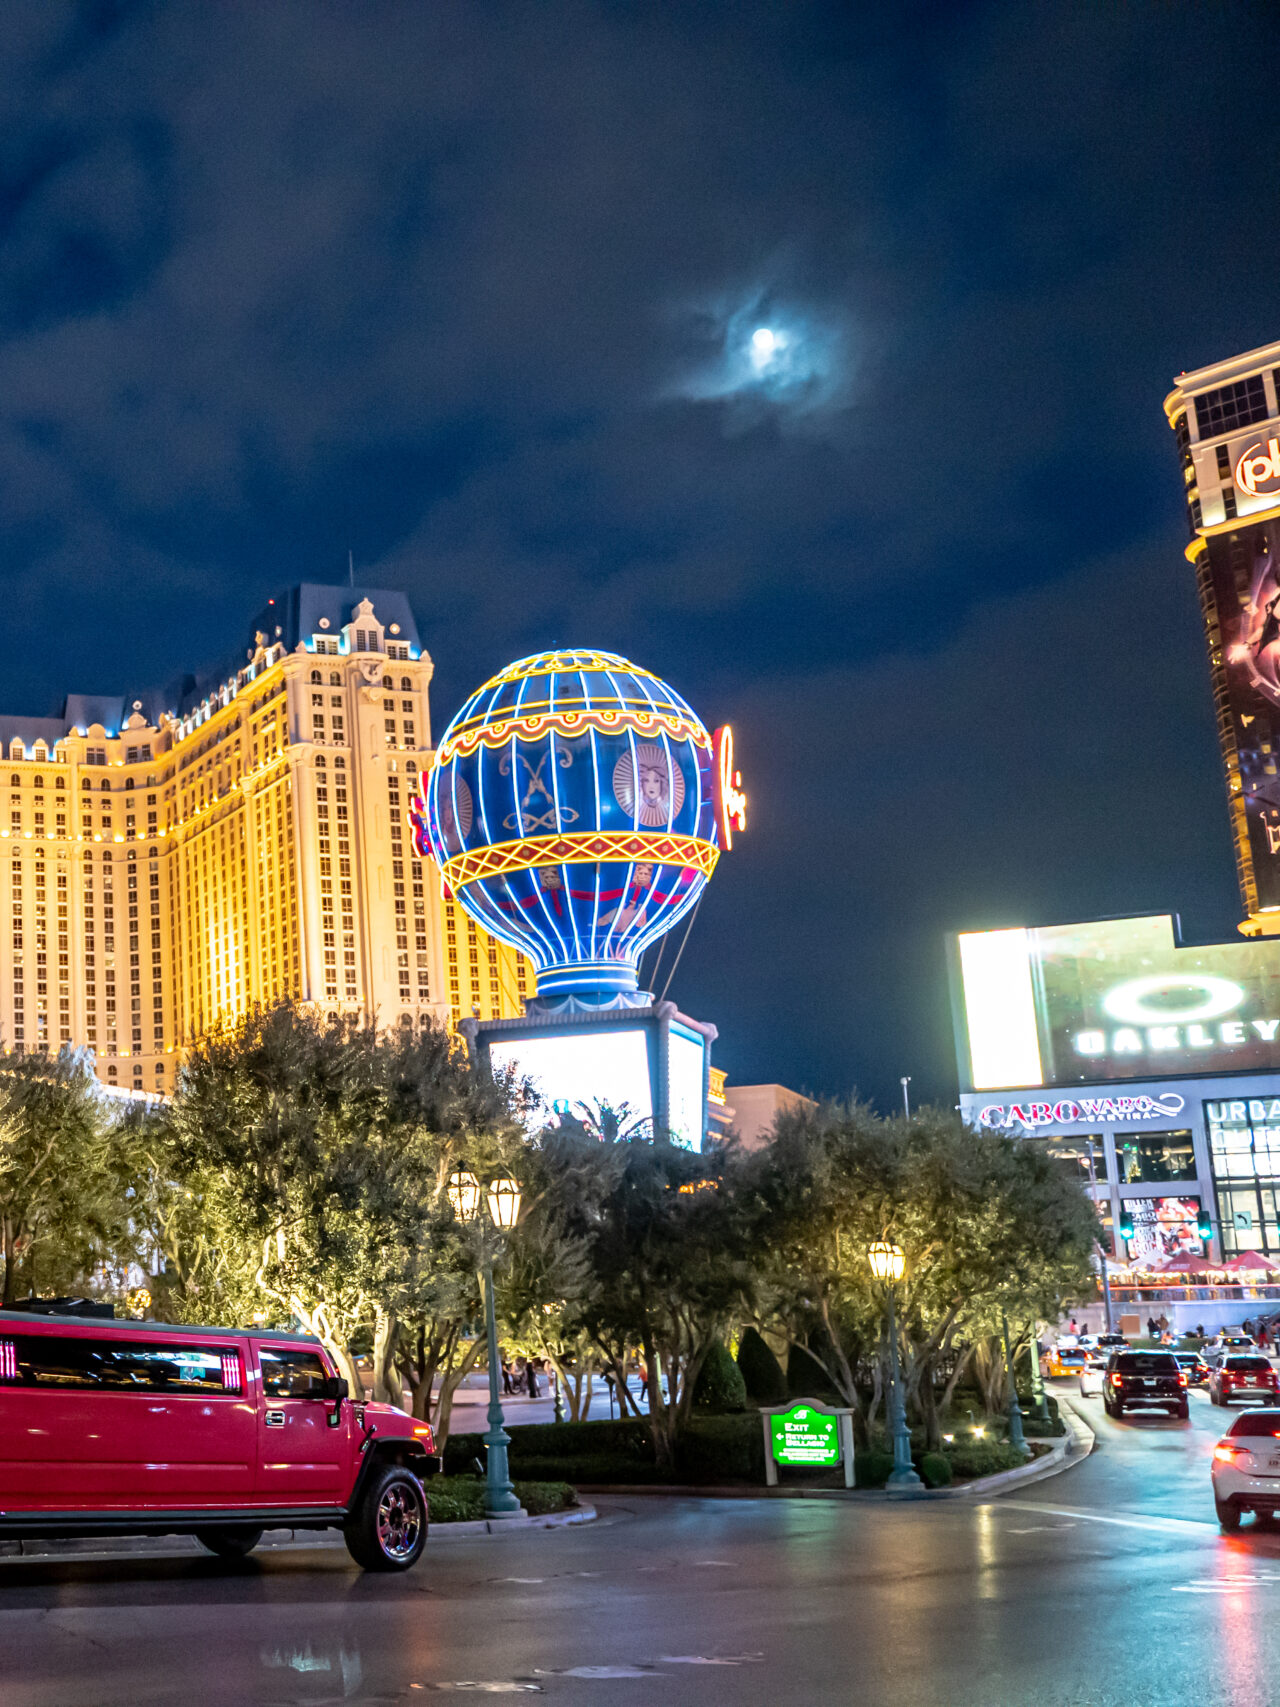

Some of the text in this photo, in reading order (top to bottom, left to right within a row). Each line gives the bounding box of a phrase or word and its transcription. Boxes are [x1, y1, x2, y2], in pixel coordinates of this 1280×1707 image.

[1077, 1020, 1280, 1054] OAKLEY
[979, 1095, 1154, 1130] CABO WABO
[1087, 1112, 1152, 1123] CANTINA
